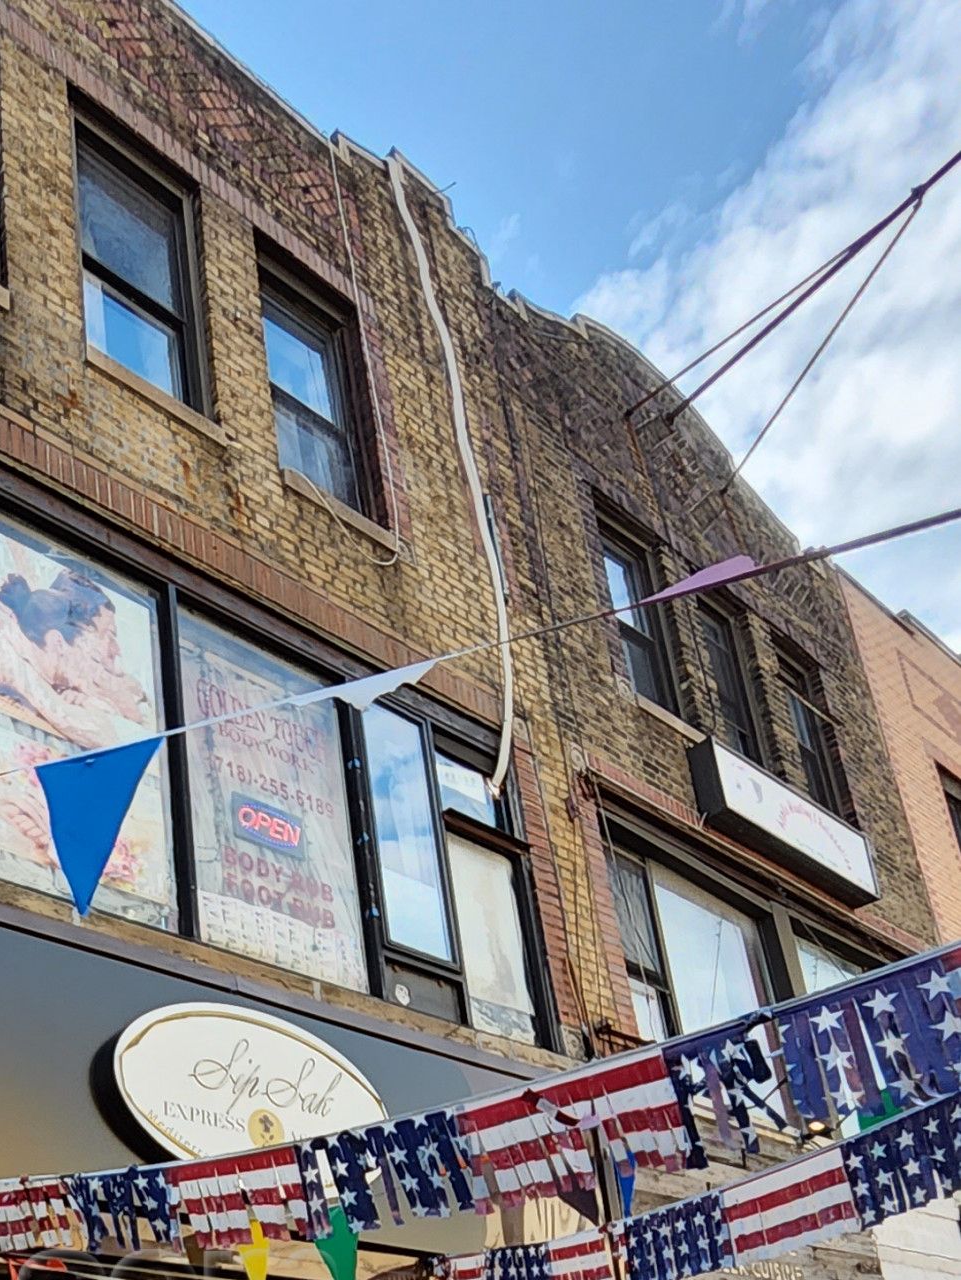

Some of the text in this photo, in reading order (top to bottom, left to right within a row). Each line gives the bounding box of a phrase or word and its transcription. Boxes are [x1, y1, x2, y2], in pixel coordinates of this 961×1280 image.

[237, 806, 301, 847] OPEN
[222, 845, 283, 883] BODY
[223, 873, 285, 911] FOOT
[162, 1101, 246, 1133] EXPRESS
